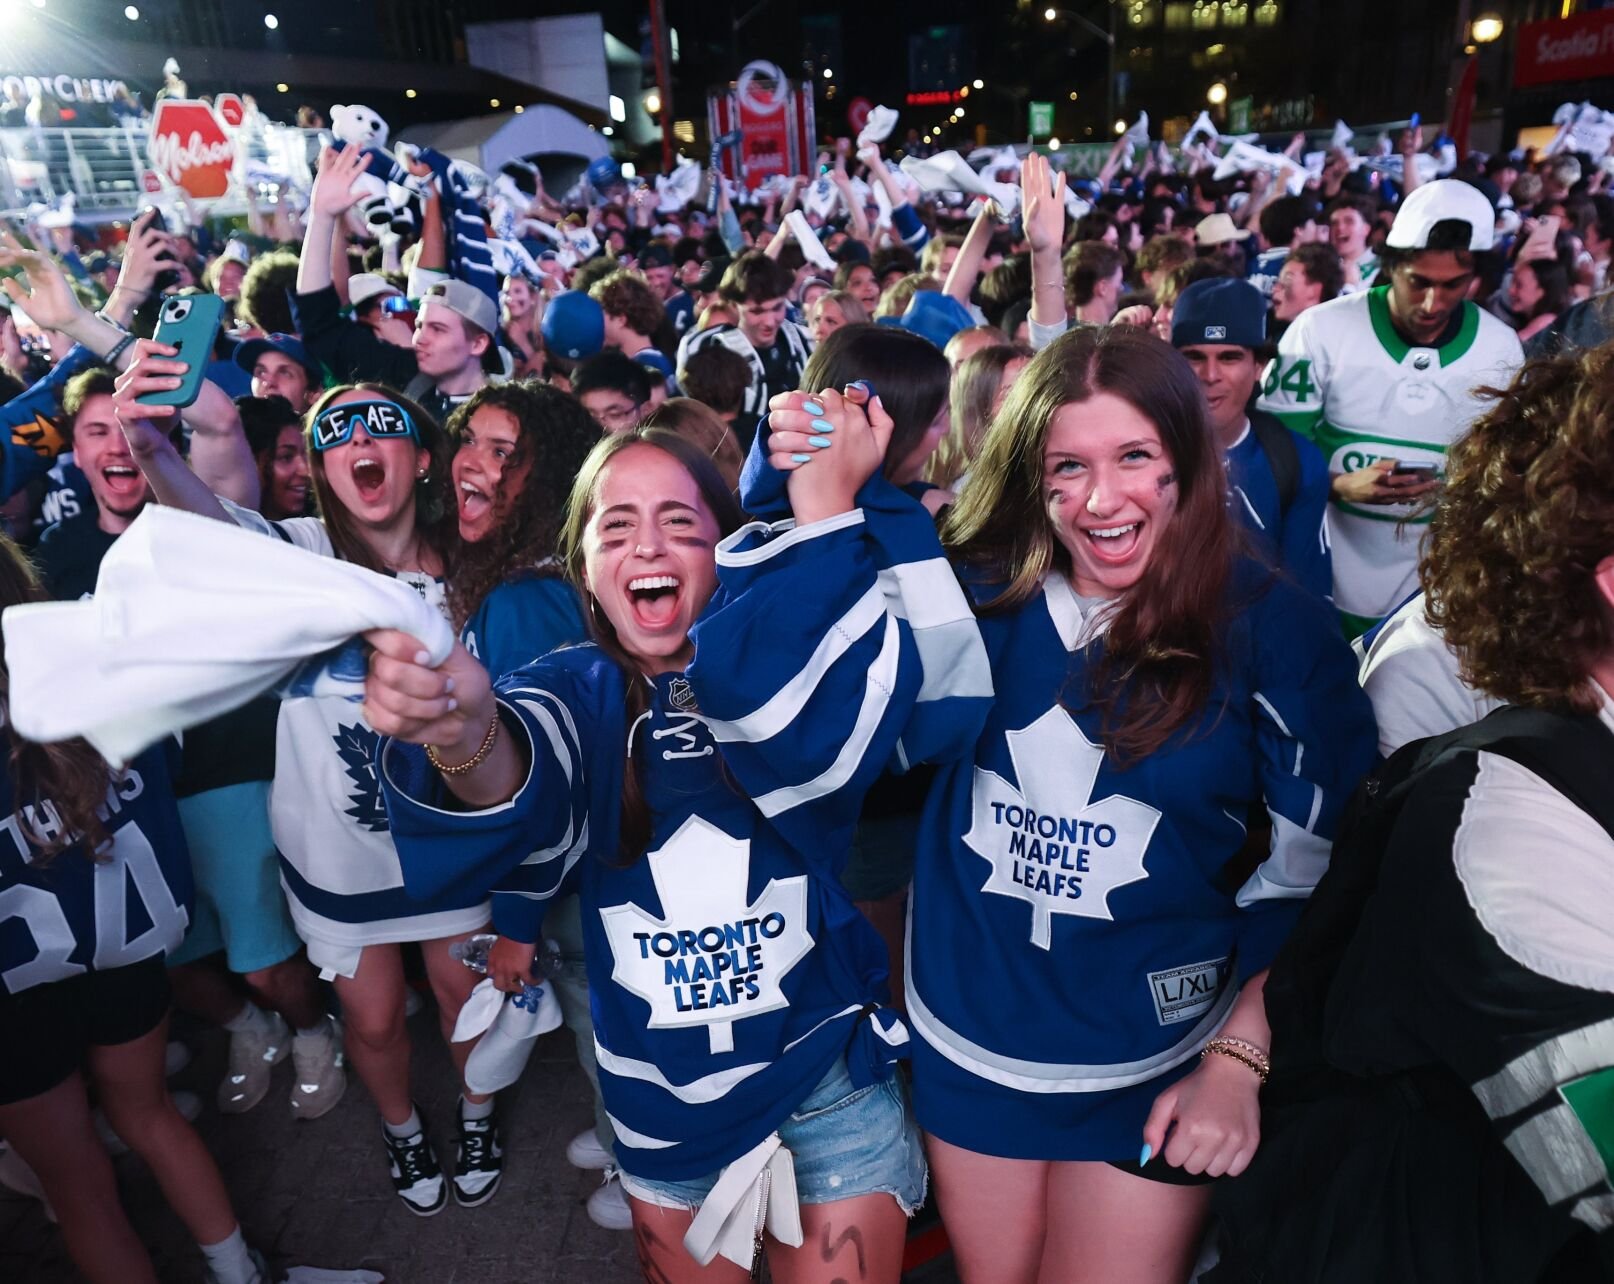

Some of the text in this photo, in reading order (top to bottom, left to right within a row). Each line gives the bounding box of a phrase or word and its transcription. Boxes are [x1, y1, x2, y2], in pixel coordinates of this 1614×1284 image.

[148, 130, 236, 183] Molson
[991, 801, 1116, 848] TORONTO
[1009, 831, 1090, 873] MAPLE
[1012, 860, 1083, 900] LEAFS
[632, 911, 786, 959] TORONTO
[664, 943, 764, 985] MAPLE
[673, 974, 760, 1013] LEAFS
[1160, 973, 1215, 1003] L/XL
